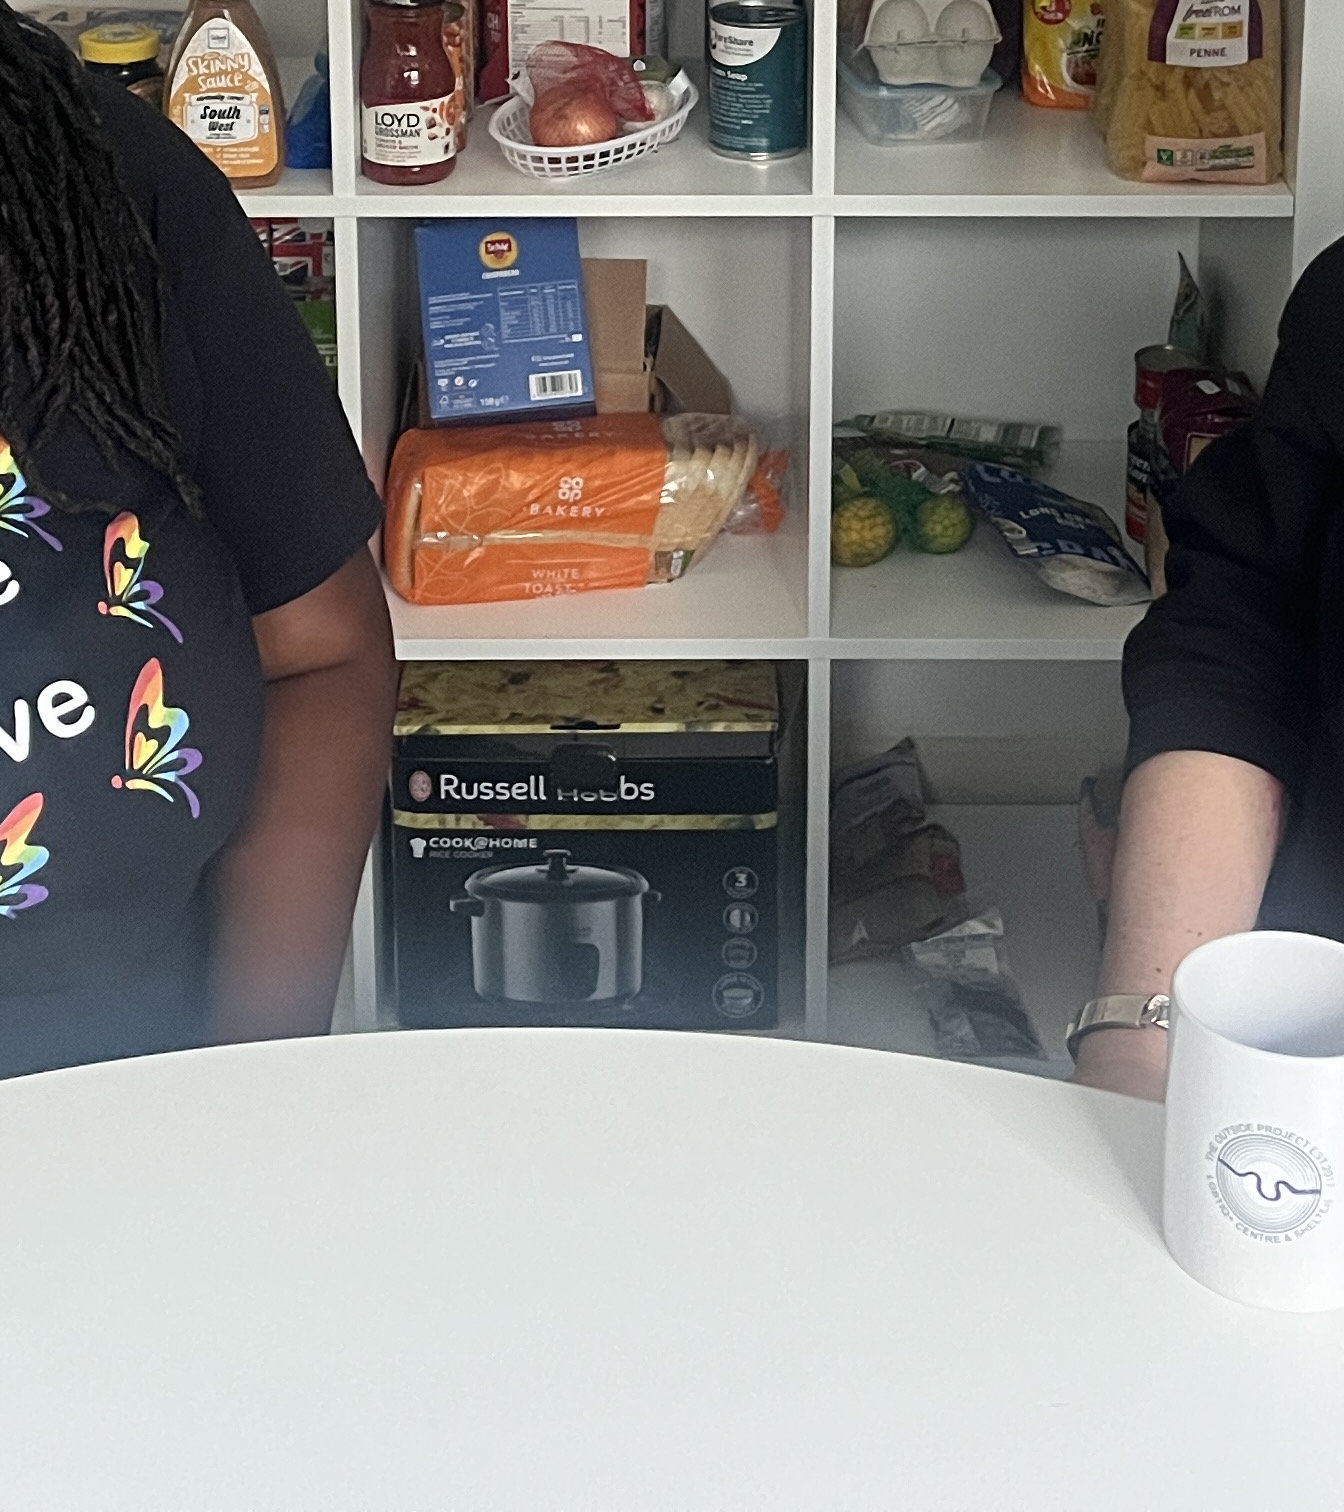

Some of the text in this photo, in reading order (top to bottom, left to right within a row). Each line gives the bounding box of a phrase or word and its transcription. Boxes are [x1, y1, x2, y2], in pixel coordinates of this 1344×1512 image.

[1189, 47, 1227, 58] PENNE
[187, 52, 251, 76] SKINNY
[200, 105, 241, 120] South
[374, 111, 420, 128] LOYD
[207, 121, 235, 132] West
[530, 503, 605, 517] BAKERY
[531, 568, 580, 579] WHITE
[439, 774, 547, 800] Russell
[428, 836, 538, 850] COOK@HOME
[735, 873, 747, 887] 3
[1214, 1123, 1255, 1144] OUTSIDE
[1257, 1123, 1311, 1148] PROJECT
[1235, 1222, 1281, 1243] CENTRE
